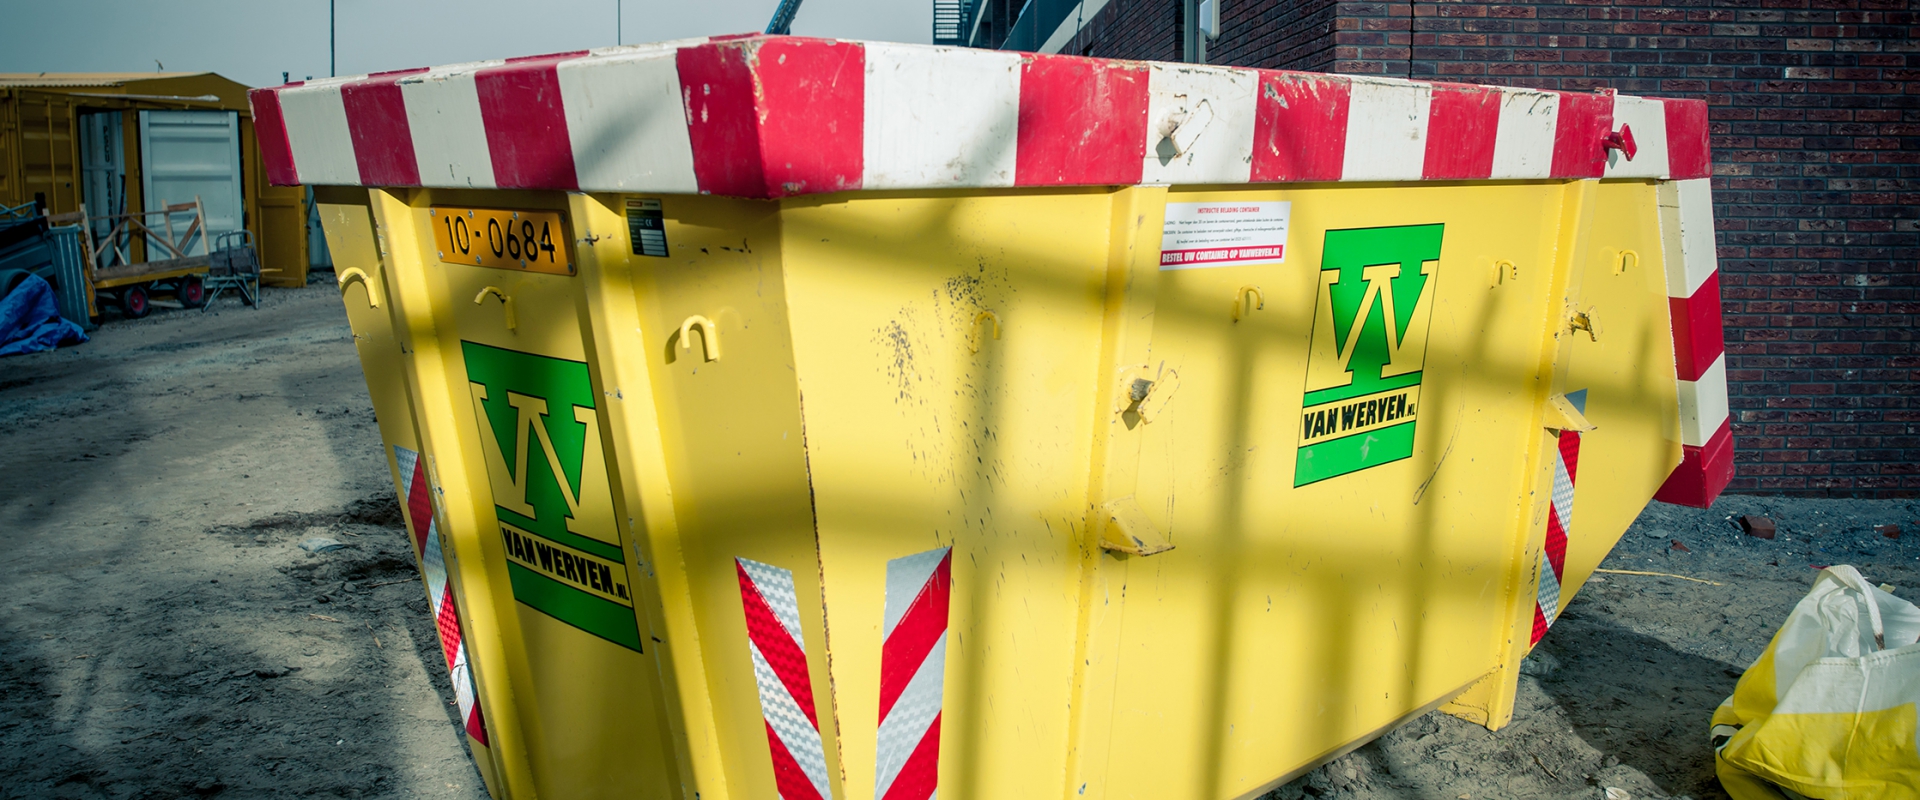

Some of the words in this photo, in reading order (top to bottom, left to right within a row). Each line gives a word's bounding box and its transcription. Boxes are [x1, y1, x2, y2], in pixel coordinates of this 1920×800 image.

[445, 215, 557, 263] 10-0684
[1162, 253, 1183, 262] BESTEL
[1184, 251, 1196, 262] UW
[1196, 250, 1228, 261] CONTAINER
[1229, 249, 1238, 259] OP
[1238, 247, 1280, 258] VANWERVEN.NL
[1304, 407, 1338, 440] VAN
[502, 527, 537, 570] VAN
